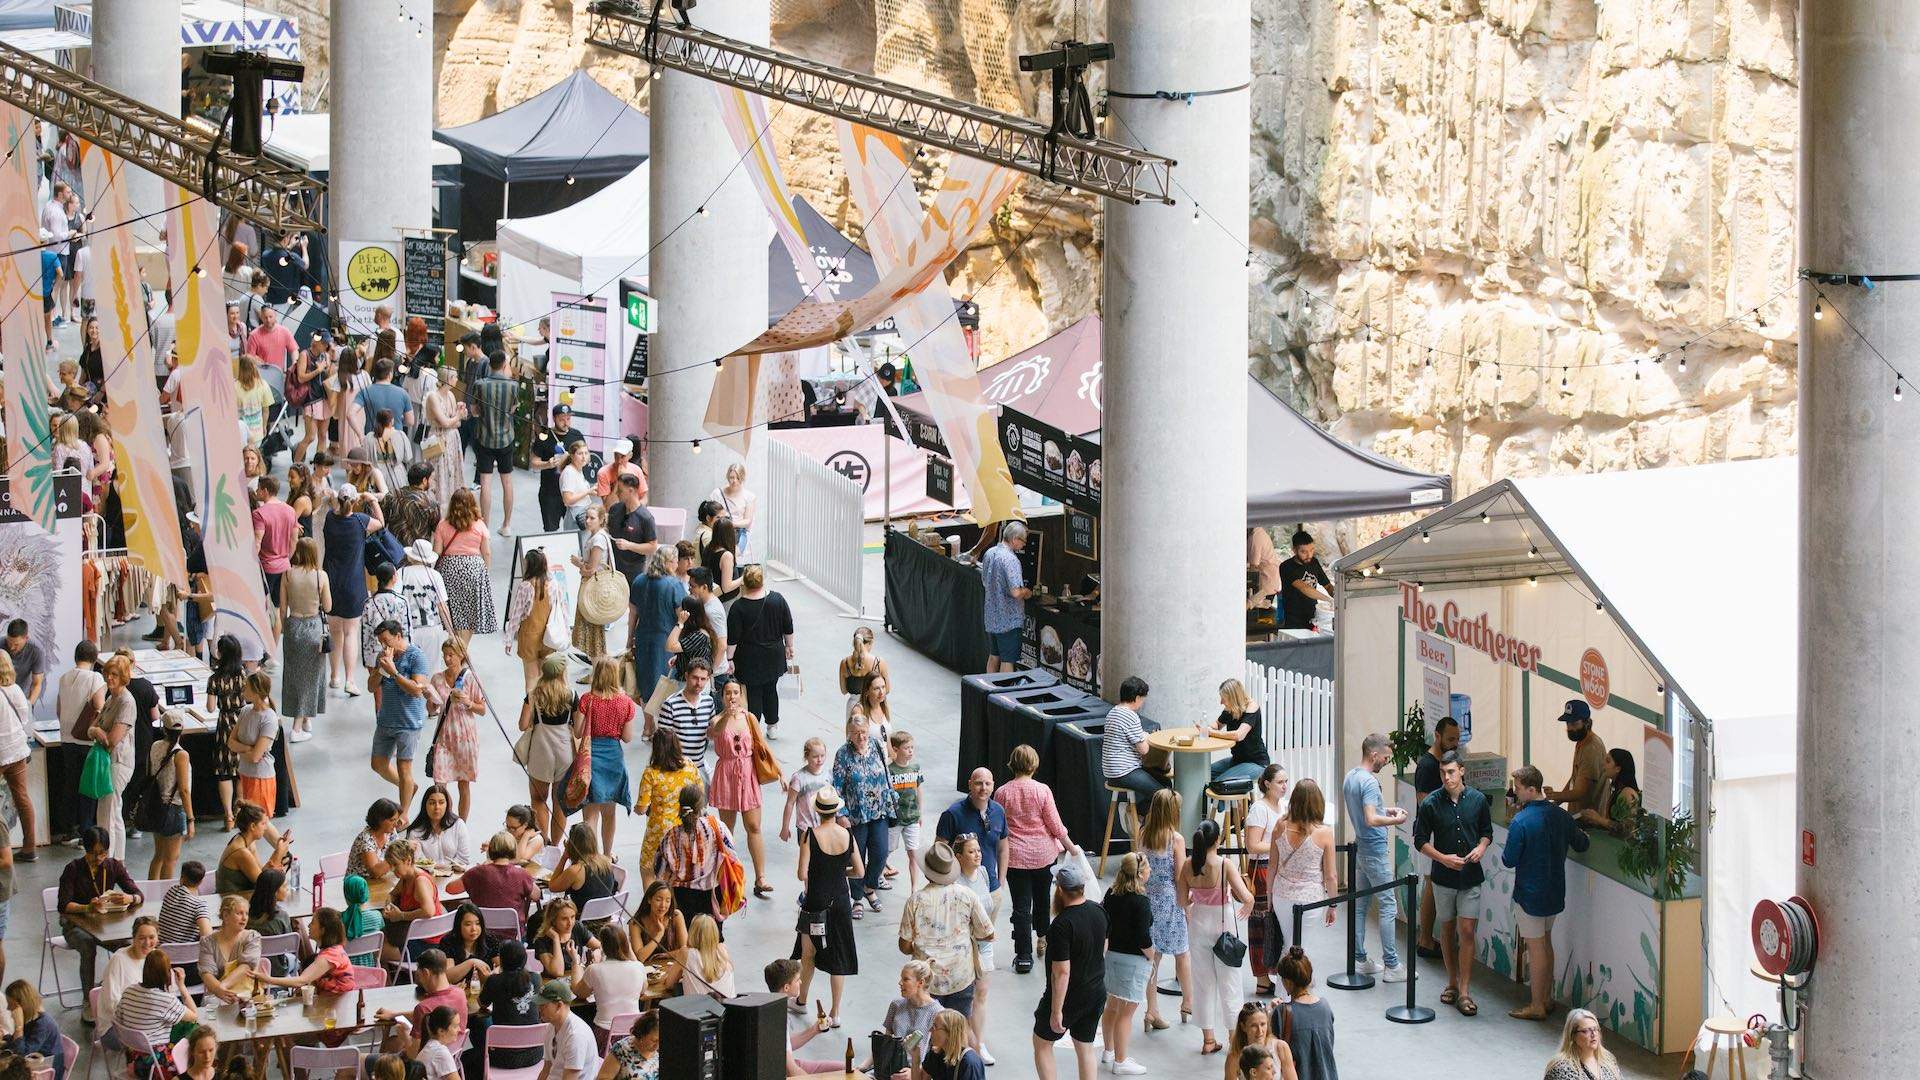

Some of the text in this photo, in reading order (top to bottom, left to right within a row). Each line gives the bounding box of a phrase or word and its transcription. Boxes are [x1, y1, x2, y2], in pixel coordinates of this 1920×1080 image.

[358, 253, 387, 264] Bird
[1072, 516, 1090, 532] ORDER
[1074, 532, 1090, 548] HERE
[1399, 580, 1541, 672] The Gatherer
[1420, 640, 1448, 668] Beer,
[1583, 660, 1605, 677] STONE
[1584, 678, 1605, 698] WOOD
